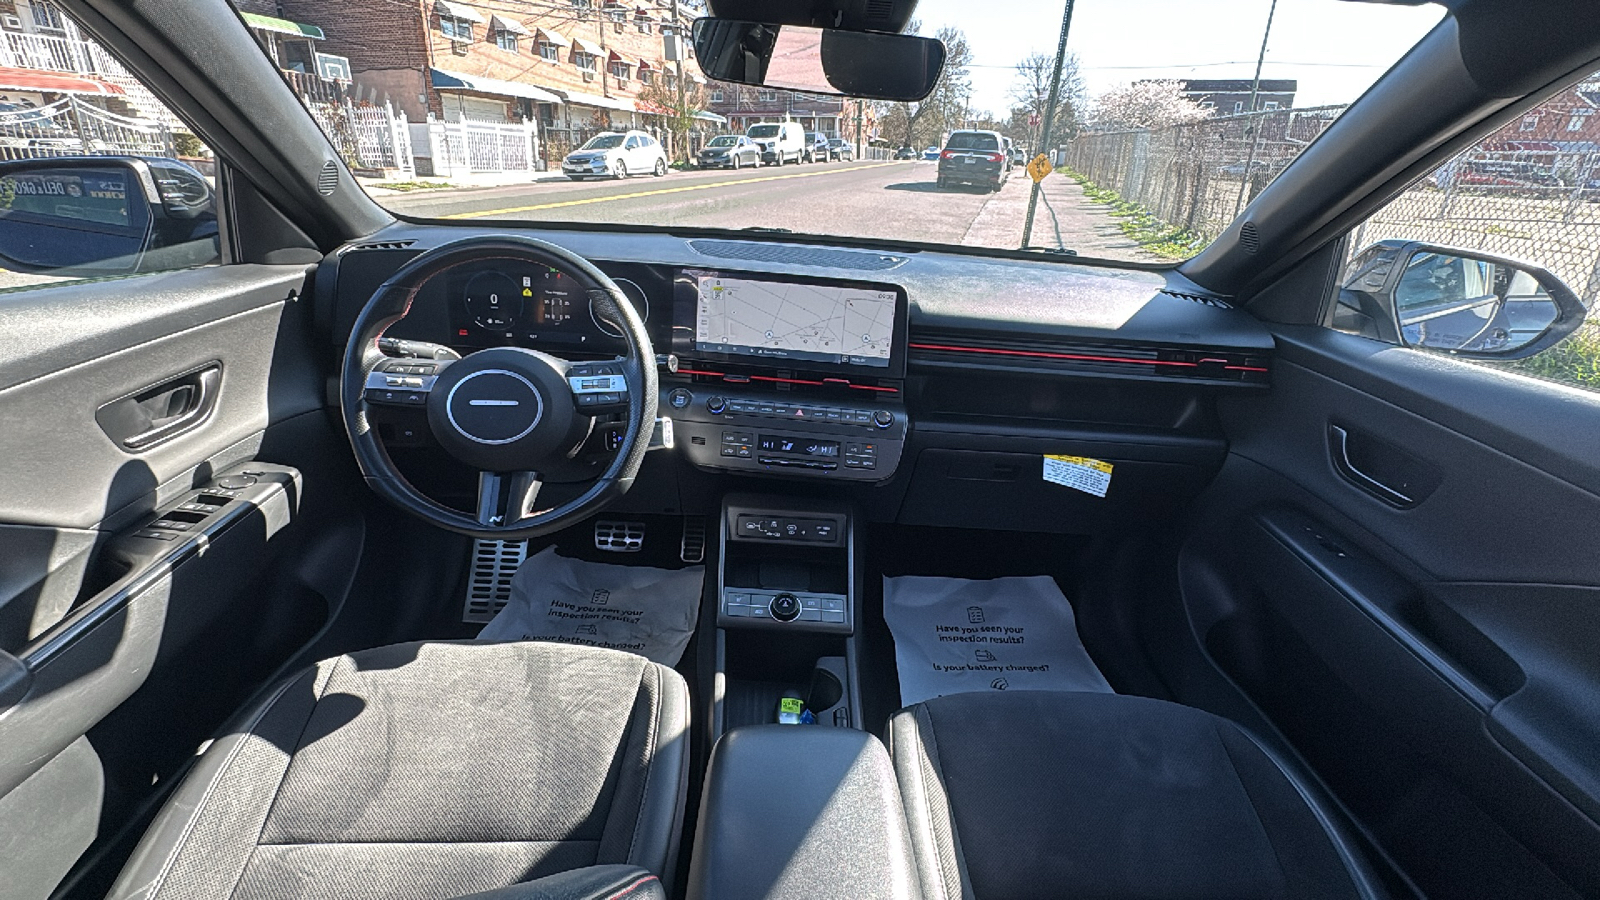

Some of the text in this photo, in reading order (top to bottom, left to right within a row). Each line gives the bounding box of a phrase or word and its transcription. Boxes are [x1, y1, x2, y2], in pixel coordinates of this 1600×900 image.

[489, 293, 499, 304] 0
[551, 600, 575, 610] Have
[621, 609, 643, 617] your
[601, 614, 640, 624] results?
[961, 626, 979, 634] you
[1004, 626, 1024, 635] your
[558, 635, 597, 646] battery
[939, 634, 1024, 644] inspection results?
[933, 663, 942, 671] Is
[966, 663, 1004, 672] battery
[1006, 664, 1050, 672] charged?
